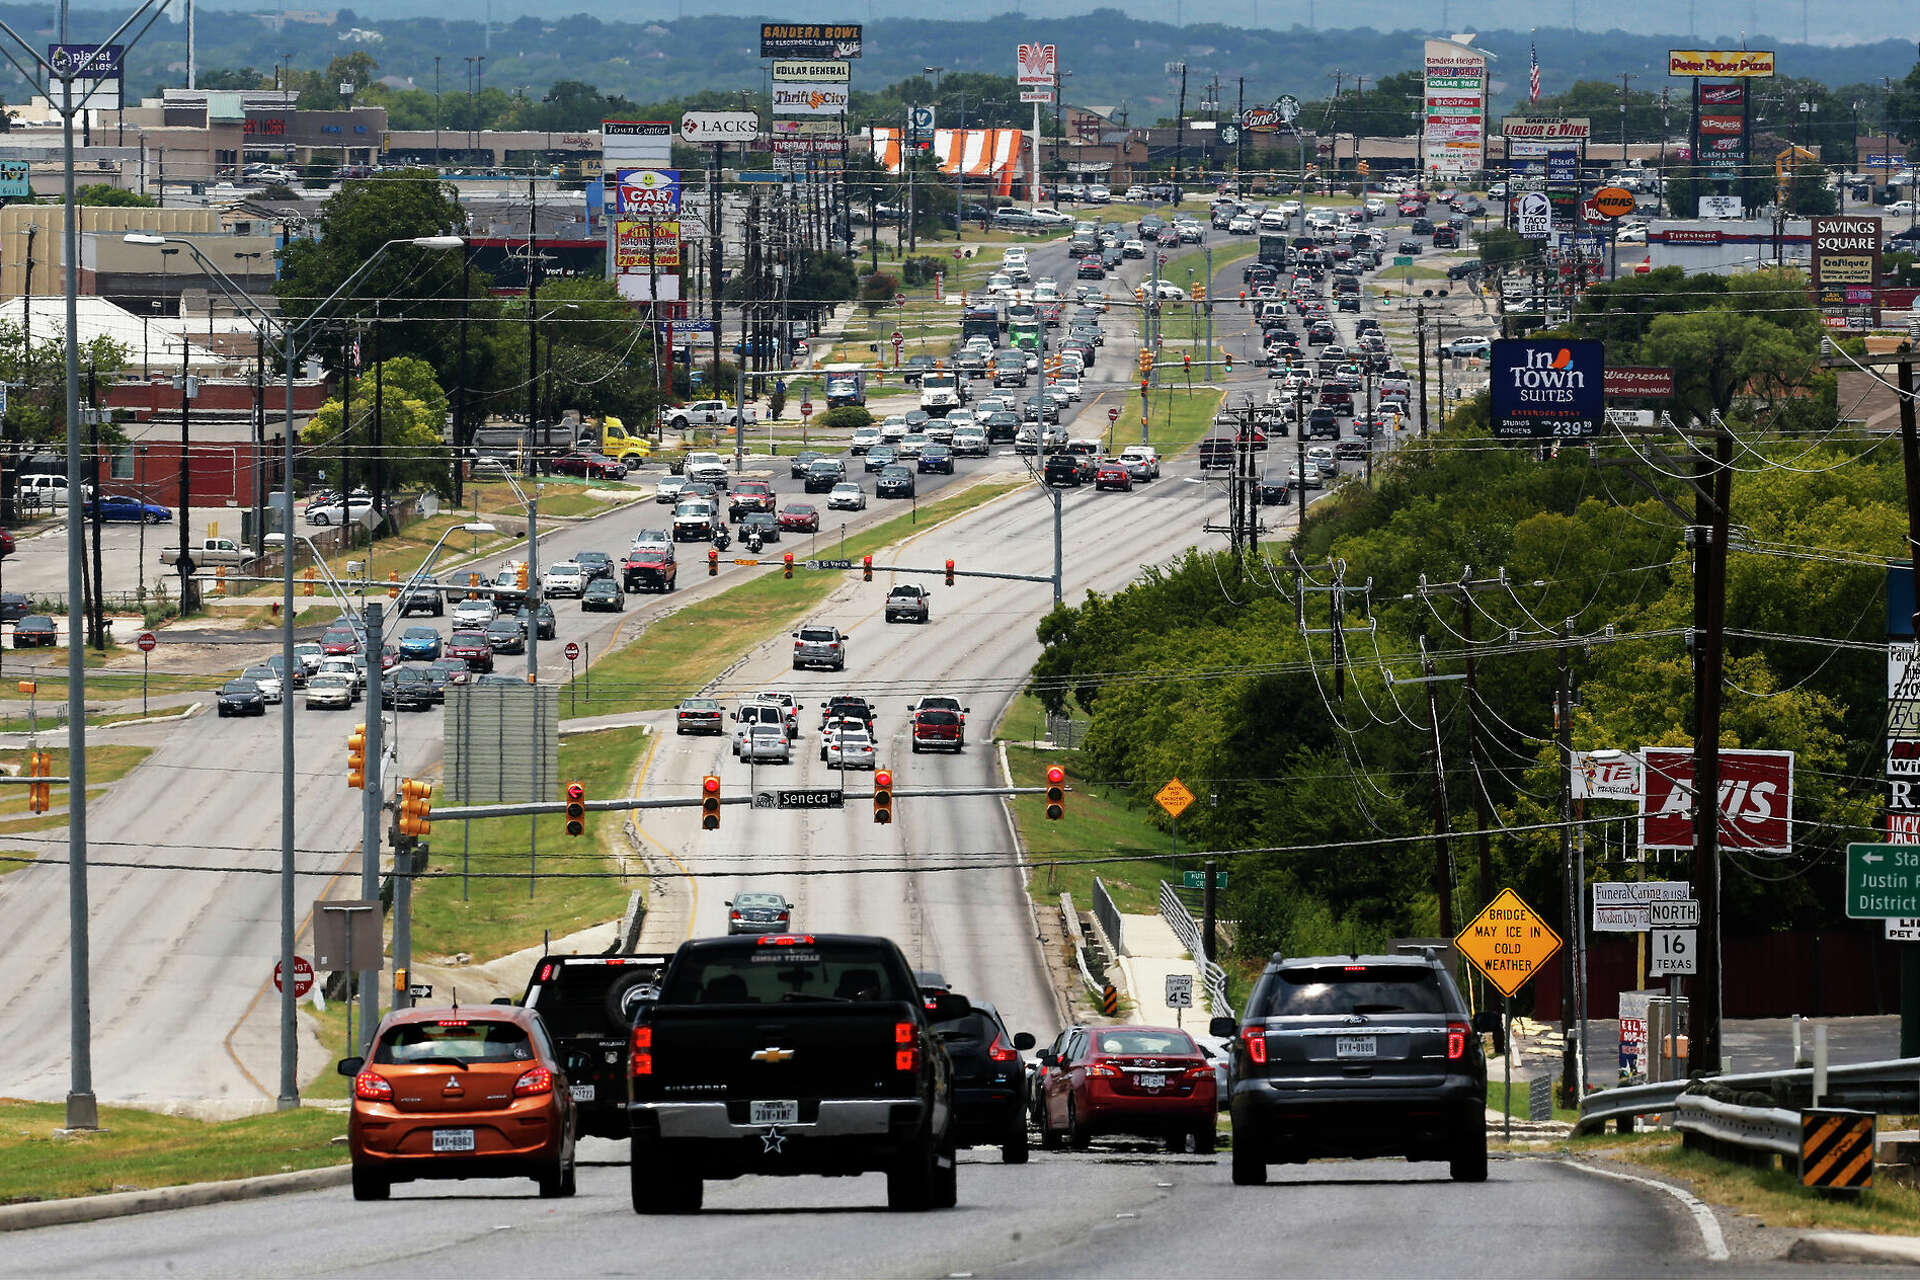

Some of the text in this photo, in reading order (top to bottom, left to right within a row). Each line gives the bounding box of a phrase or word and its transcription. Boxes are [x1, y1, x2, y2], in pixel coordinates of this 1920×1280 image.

[763, 26, 859, 38] BANDERA BOWL
[776, 66, 847, 75] DOLLAR GENERAL
[1671, 57, 1772, 72] Peter Piper Pizza
[774, 90, 847, 105] Thrift City
[608, 125, 668, 135] Town Center
[702, 121, 758, 132] LACKS
[1504, 123, 1588, 136] LIQUOR & WINE
[630, 190, 668, 202] CAR
[623, 201, 677, 212] WASH
[1597, 198, 1632, 207] MIDAS
[1524, 224, 1546, 232] BELL
[1817, 221, 1876, 234] SAVINGS
[639, 238, 677, 246] INSRANCE
[1668, 232, 1717, 240] Firestone
[1817, 237, 1876, 251] SQUARE
[1526, 349, 1554, 369] In
[1510, 367, 1585, 389] Town
[1603, 371, 1671, 382] Walgreens
[1520, 389, 1574, 402] SUITES
[1553, 421, 1581, 435] 239
[783, 793, 828, 805] Seneca
[1861, 873, 1908, 889] Justin
[1596, 885, 1630, 900] Funeral
[1631, 885, 1661, 902] Caring
[1860, 894, 1917, 911] District
[1489, 909, 1526, 920] BRIDGE
[1652, 905, 1697, 920] NORTH
[1475, 926, 1541, 938] MAY ICE IN
[1889, 930, 1912, 938] PET
[1494, 943, 1521, 954] COLD
[1663, 934, 1686, 954] 16
[1484, 959, 1533, 971] WEATHER
[1656, 959, 1692, 969] TEXAS
[1168, 993, 1190, 1005] 45
